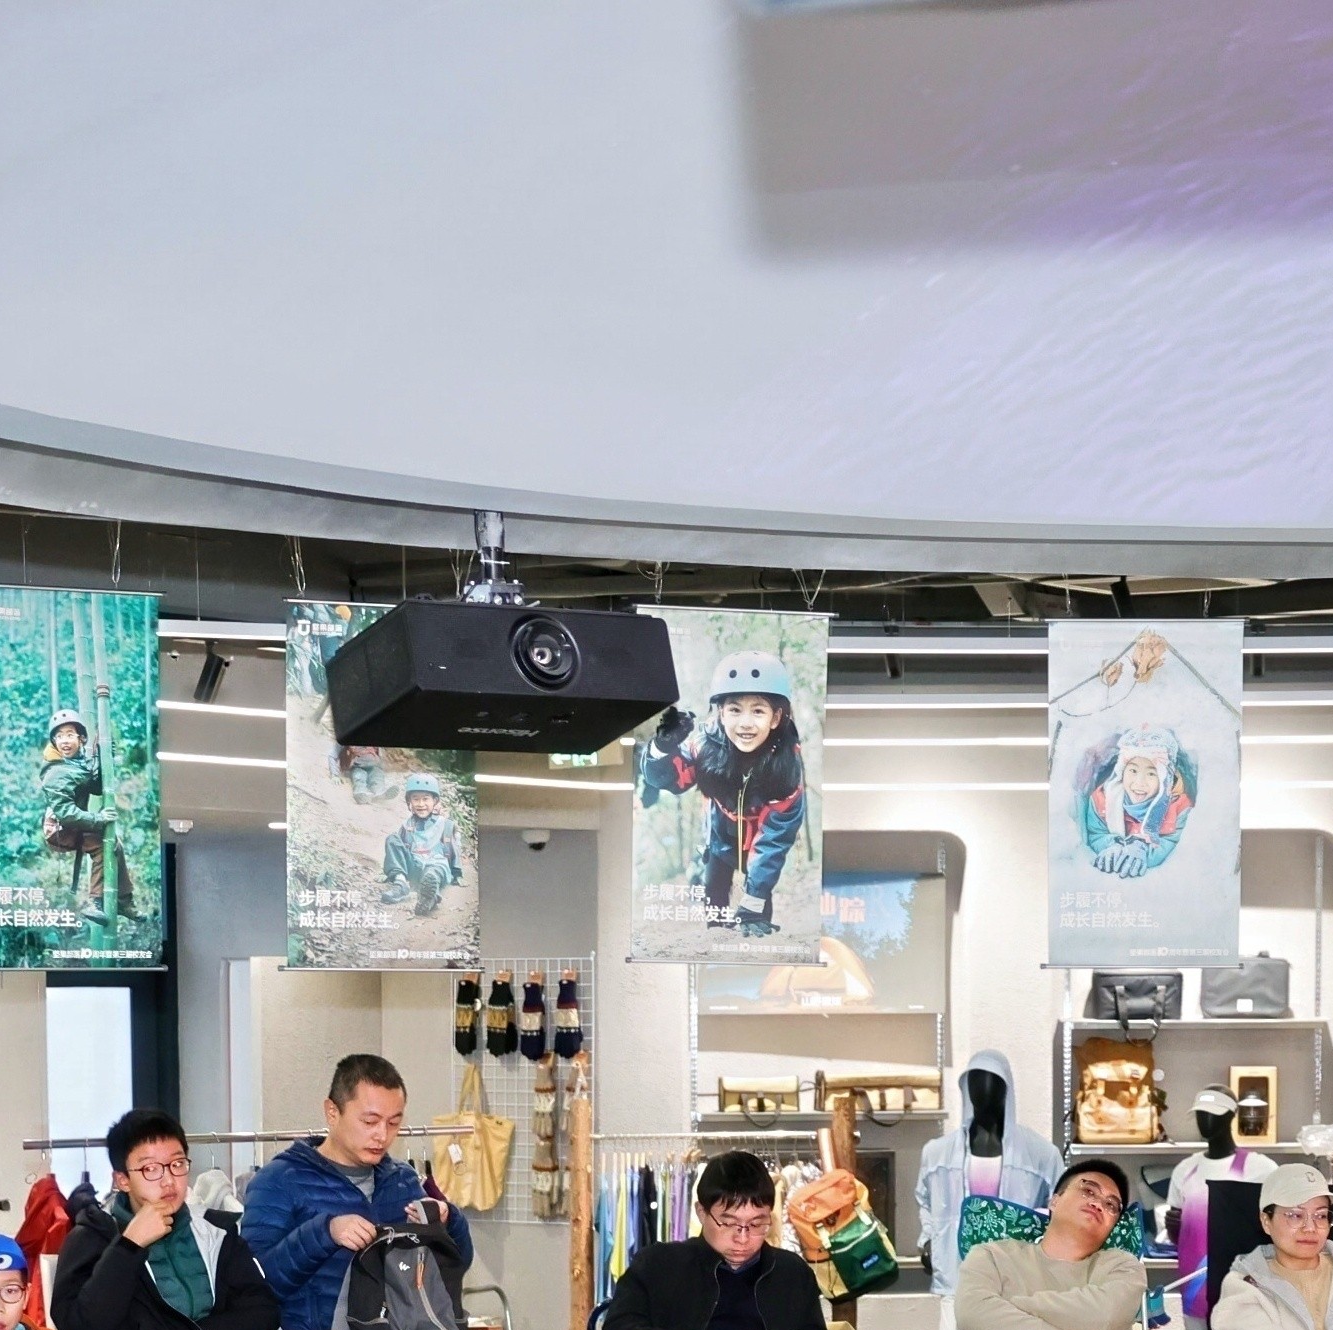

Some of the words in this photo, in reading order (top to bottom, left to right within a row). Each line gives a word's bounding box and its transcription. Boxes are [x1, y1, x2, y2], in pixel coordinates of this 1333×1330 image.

[299, 912, 400, 929] 成长自然发生。
[643, 906, 742, 924] 成长自然发生。
[1059, 912, 1160, 928] 成长自然发生。
